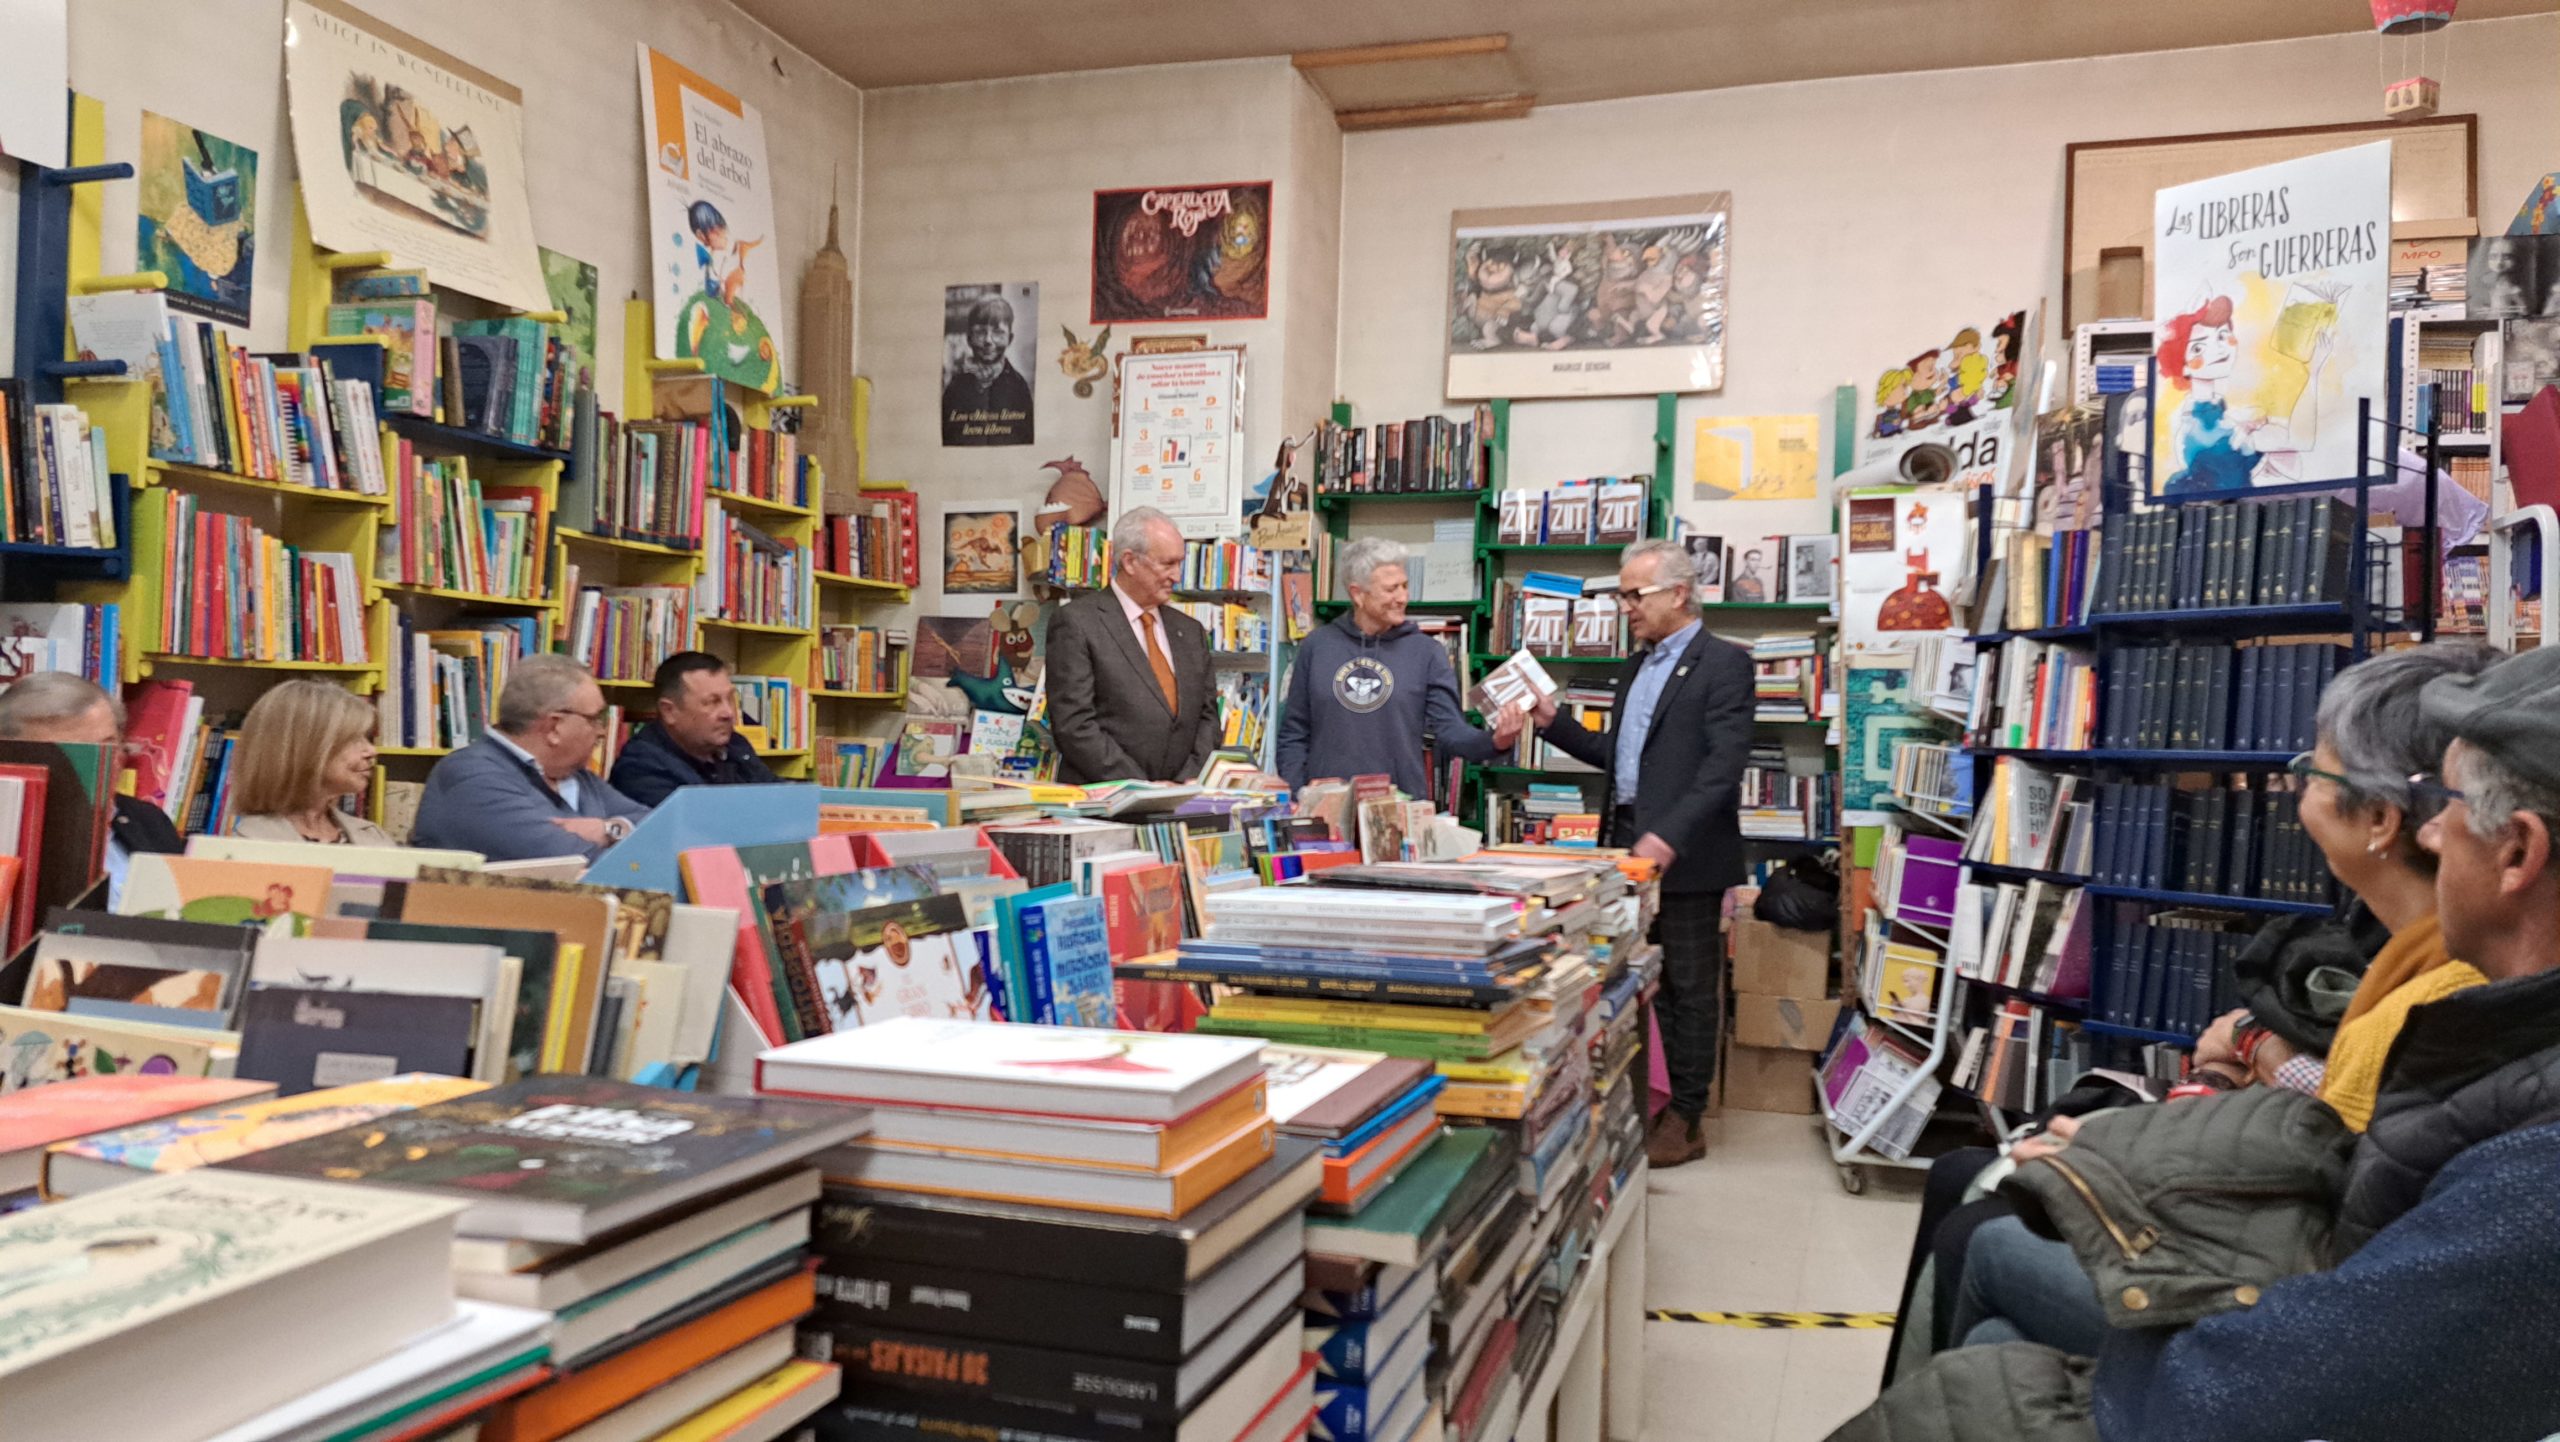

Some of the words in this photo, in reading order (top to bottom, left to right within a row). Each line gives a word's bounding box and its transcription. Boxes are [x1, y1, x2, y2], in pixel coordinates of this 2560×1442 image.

[694, 121, 708, 145] El
[711, 133, 752, 169] abrazo
[697, 147, 716, 171] del
[719, 158, 751, 190] árbol
[2165, 205, 2193, 237] Las
[2198, 186, 2290, 240] LIBRERAS
[2227, 240, 2257, 270] Son
[2259, 221, 2377, 279] GUERRERAS
[2401, 250, 2441, 260] MPO
[1072, 1371, 1158, 1401] LAROUSSE
